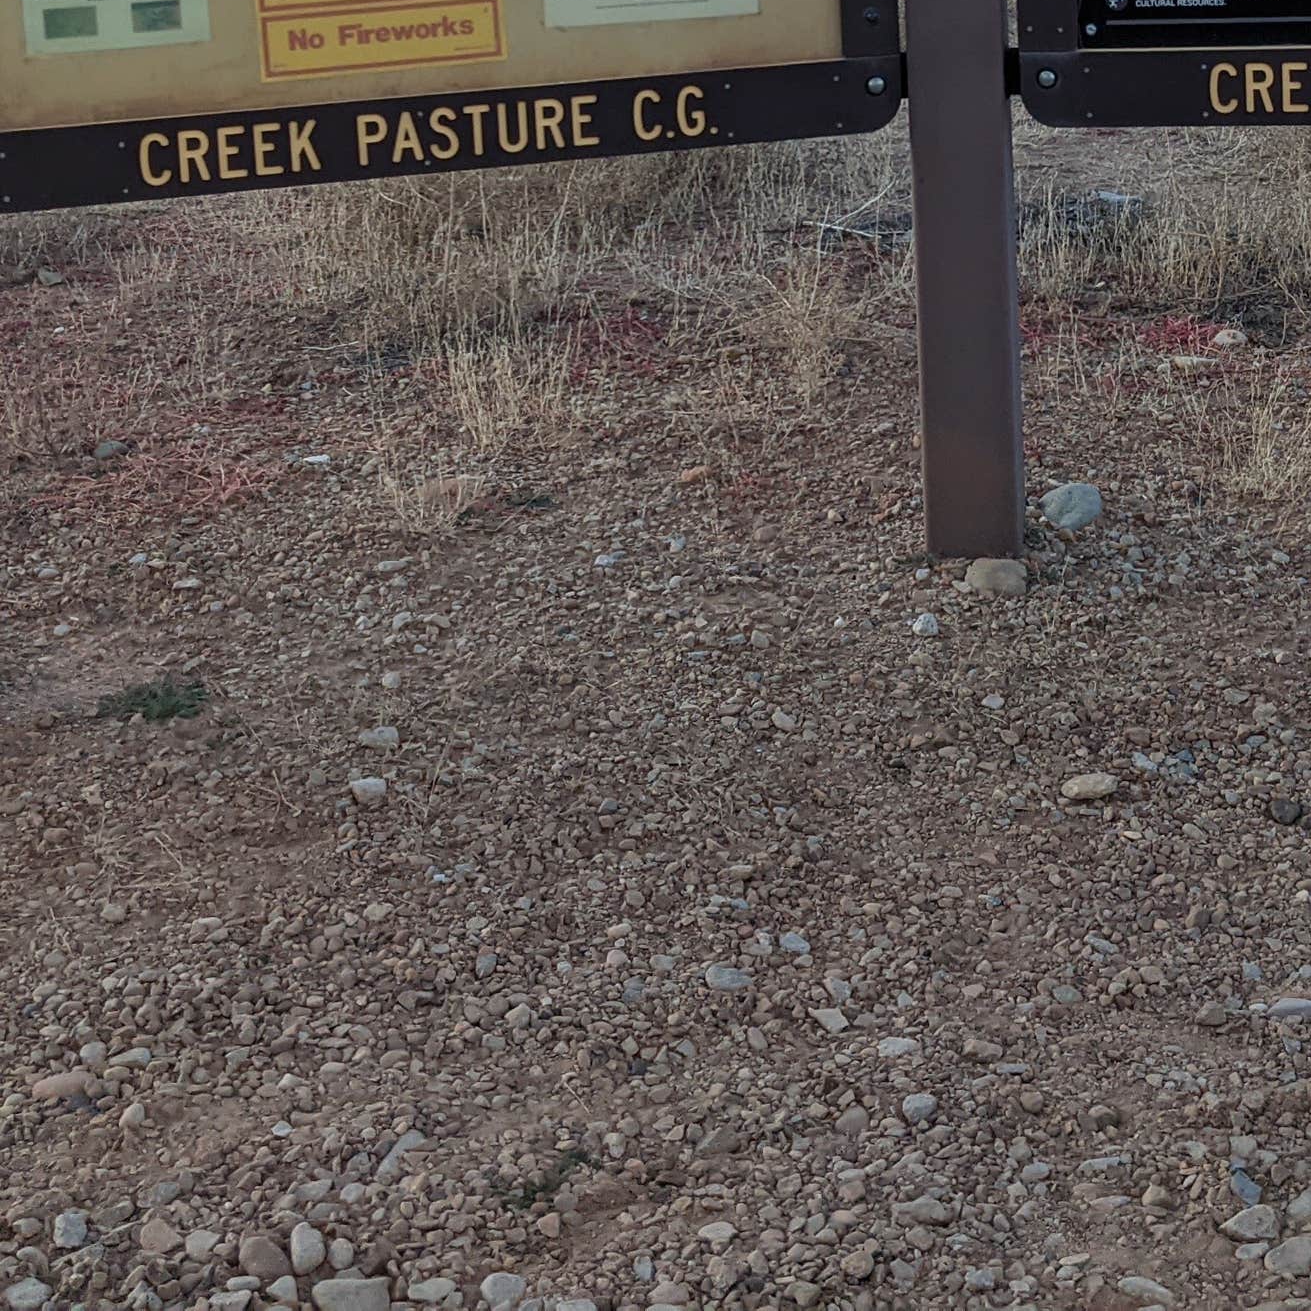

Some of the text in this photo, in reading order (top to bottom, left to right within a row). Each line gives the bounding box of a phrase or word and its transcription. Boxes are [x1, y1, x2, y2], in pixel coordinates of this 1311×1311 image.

[287, 15, 474, 51] No Fireworks
[140, 85, 719, 187] CREEK PASTURE C.G.
